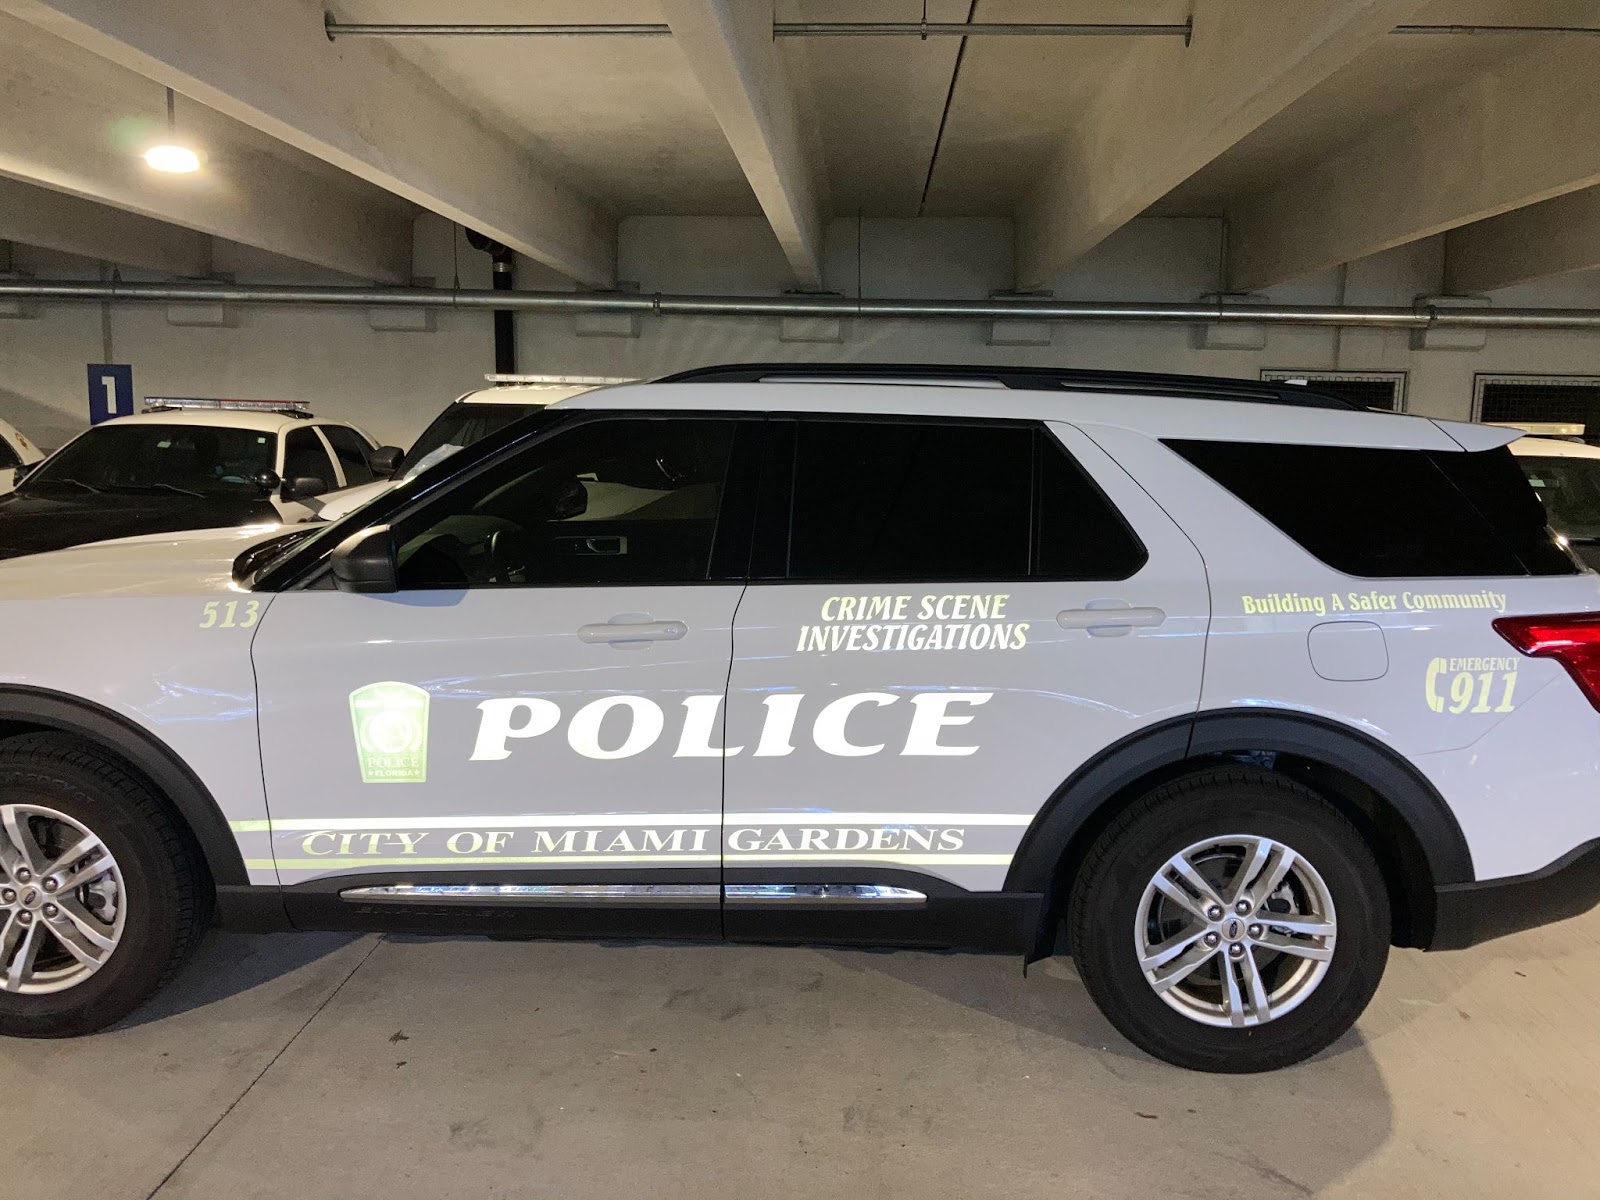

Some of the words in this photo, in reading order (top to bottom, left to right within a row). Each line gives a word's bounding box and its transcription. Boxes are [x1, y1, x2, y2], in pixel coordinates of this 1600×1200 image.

[102, 376, 117, 413] 1
[199, 600, 260, 628] 513
[821, 596, 912, 621] CRIME
[917, 594, 1010, 620] SCENE
[1242, 594, 1326, 616] Building
[1332, 593, 1344, 611] A
[1349, 591, 1397, 611] Safer
[1402, 590, 1507, 612] Community
[796, 623, 1030, 651] INVESTIGATIONS
[1449, 657, 1520, 671] EMERGENCY
[1448, 672, 1518, 714] 911
[468, 692, 994, 761] POLICE
[302, 830, 430, 855] CITY
[446, 831, 514, 854] OF
[530, 828, 710, 853] MIAMI
[728, 828, 965, 851] GARDENS
